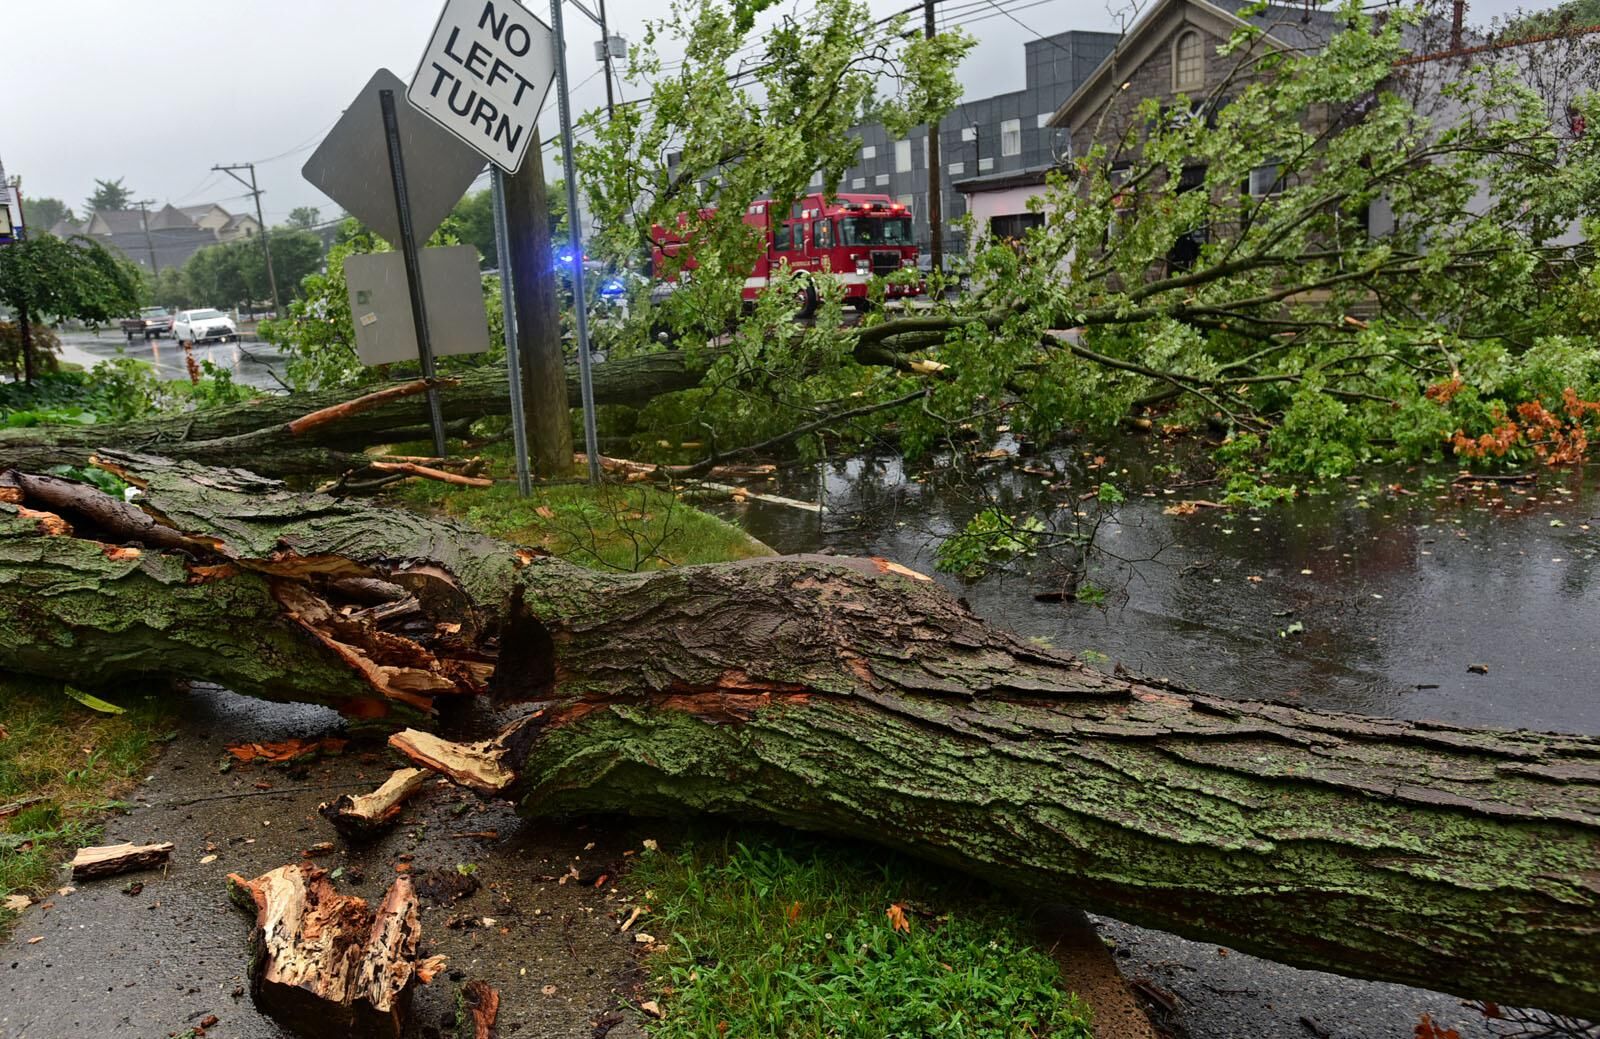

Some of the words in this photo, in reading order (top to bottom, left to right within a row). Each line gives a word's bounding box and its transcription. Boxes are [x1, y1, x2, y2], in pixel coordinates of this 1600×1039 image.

[444, 26, 535, 107] LEFT
[478, 1, 531, 57] NO
[430, 61, 523, 153] TURN
